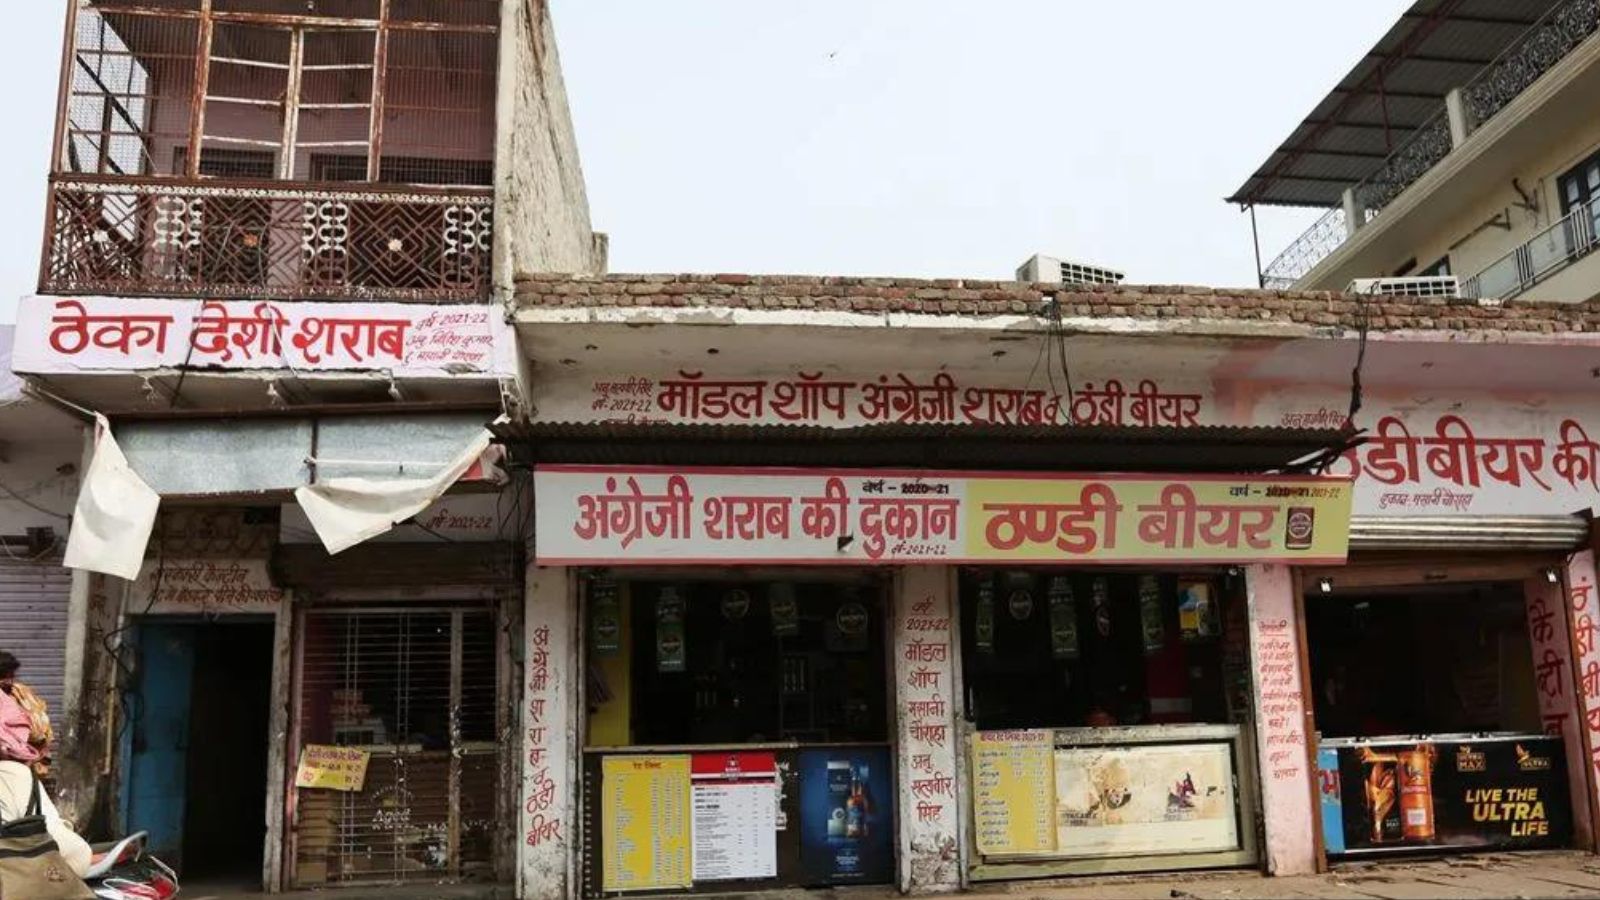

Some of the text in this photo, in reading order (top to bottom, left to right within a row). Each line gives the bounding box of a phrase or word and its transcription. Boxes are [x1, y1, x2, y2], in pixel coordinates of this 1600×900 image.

[50, 300, 411, 364] ठेका देशी शराब
[657, 370, 768, 419] मॉडल
[769, 371, 857, 420] शॉप
[858, 373, 958, 423] अंग्रेजी
[960, 387, 1047, 426] शराब
[1072, 382, 1125, 426] ठंडी
[1130, 379, 1203, 428] बीयर
[1422, 414, 1551, 491] बीयर
[1552, 419, 1600, 493] की
[862, 479, 884, 494] वर्ष
[1229, 479, 1248, 497] वर्ष
[573, 475, 960, 559] अंग्रेजी शराब की दुकान
[983, 483, 1122, 554] ठण्डी
[1137, 483, 1281, 550] बीयर
[904, 637, 948, 662] मॉडल
[908, 666, 942, 691] शॉप
[1465, 787, 1538, 803] LIVE THE
[1472, 801, 1546, 823] ULTRA
[527, 814, 563, 847] बीयर
[1510, 820, 1549, 838] LIFE
